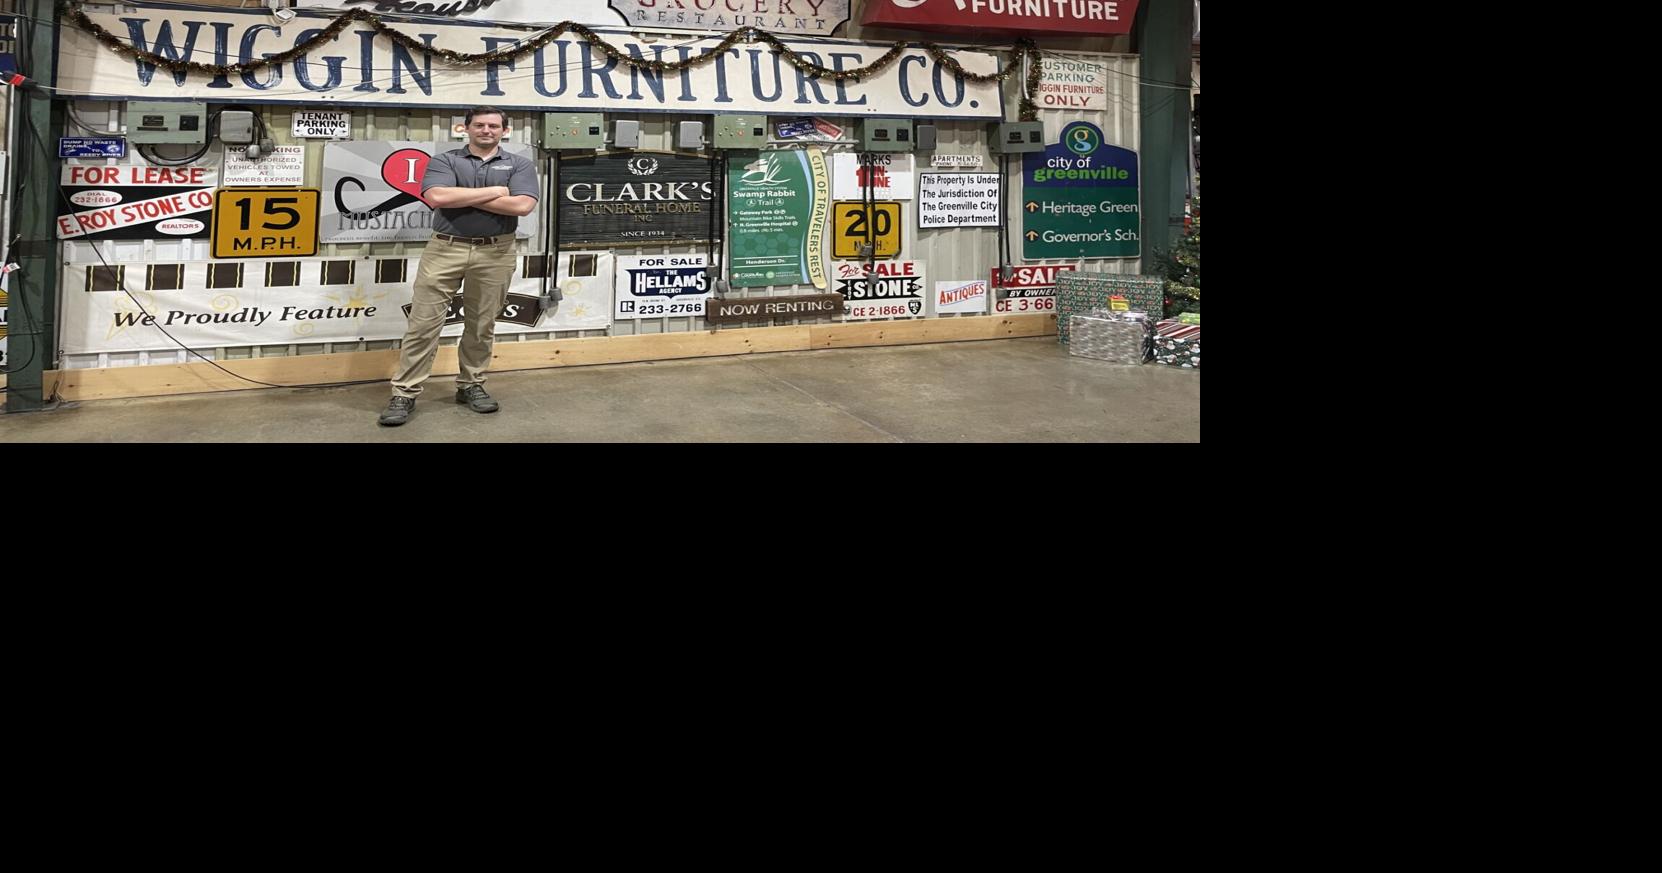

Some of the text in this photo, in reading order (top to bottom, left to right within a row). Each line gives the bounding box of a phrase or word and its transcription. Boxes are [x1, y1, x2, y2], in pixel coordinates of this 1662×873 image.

[972, 0, 1120, 21] FURNITURE
[636, 9, 826, 30] RESTAURANT
[119, 17, 979, 108] WIGGIN FURNITURE CO.
[1040, 61, 1101, 73] USTOMER
[1040, 72, 1095, 83] PARKING
[1040, 83, 1104, 94] IGGIN FURNITURE
[1044, 94, 1090, 107] ONLY
[301, 112, 344, 120] TENANT
[296, 120, 346, 128] PARKING
[307, 128, 336, 136] ONLY
[812, 155, 825, 178] CITY
[933, 155, 981, 163] APARTMENTS
[1047, 156, 1092, 170] city of
[69, 166, 206, 184] FOR LEASE
[922, 175, 1000, 187] This Property Is Under
[1033, 166, 1129, 182] greenville
[566, 181, 717, 203] CLARK'S
[733, 189, 796, 199] Swamp Rabbit
[816, 181, 827, 193] OF
[922, 188, 998, 198] The Jurisdiction Of
[120, 196, 187, 223] STONE
[234, 197, 301, 231] 15
[583, 202, 701, 215] FUNERAL HOME
[922, 201, 997, 212] The Greenville City
[1042, 200, 1139, 217] Heritage Green
[338, 210, 434, 231] MUSTACH
[634, 214, 653, 222] INC
[809, 197, 827, 253] TRAVELERS
[844, 209, 892, 237] 20
[923, 214, 997, 226] Police Department
[1042, 228, 1139, 243] Governor's Sch.
[233, 236, 301, 251] M.P.H.
[639, 257, 703, 267] FOR SALE
[809, 256, 822, 279] REST
[838, 262, 915, 279] For SALE
[1018, 266, 1070, 285] SAL
[635, 270, 707, 294] HELLAMS
[852, 279, 913, 298] STONE
[939, 282, 985, 305] ANTIQUES
[639, 303, 702, 314] 233-2766
[720, 300, 835, 316] NOW RENTING
[853, 305, 906, 316] CE 2-1866
[995, 298, 1054, 312] CE 3-66
[113, 304, 377, 327] We Proudly Feature
